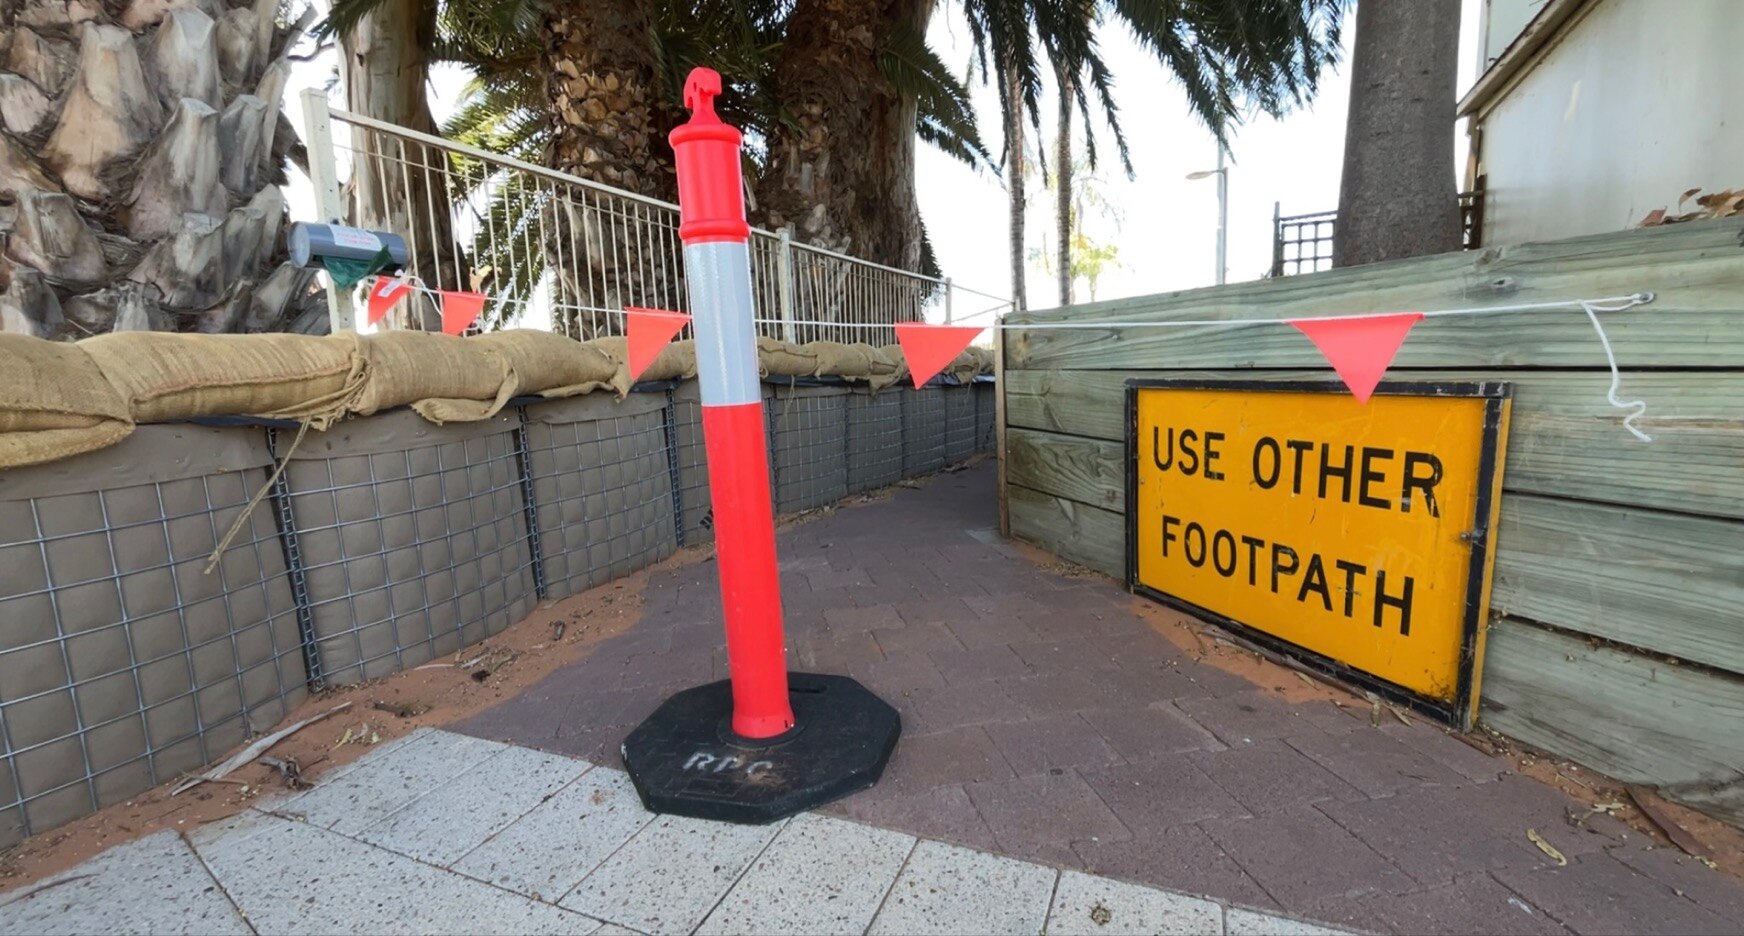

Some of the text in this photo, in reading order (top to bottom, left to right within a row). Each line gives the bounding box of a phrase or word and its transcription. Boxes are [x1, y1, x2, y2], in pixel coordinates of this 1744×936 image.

[1153, 425, 1443, 518] USE OTHER
[1162, 514, 1414, 637] FOOTPATH
